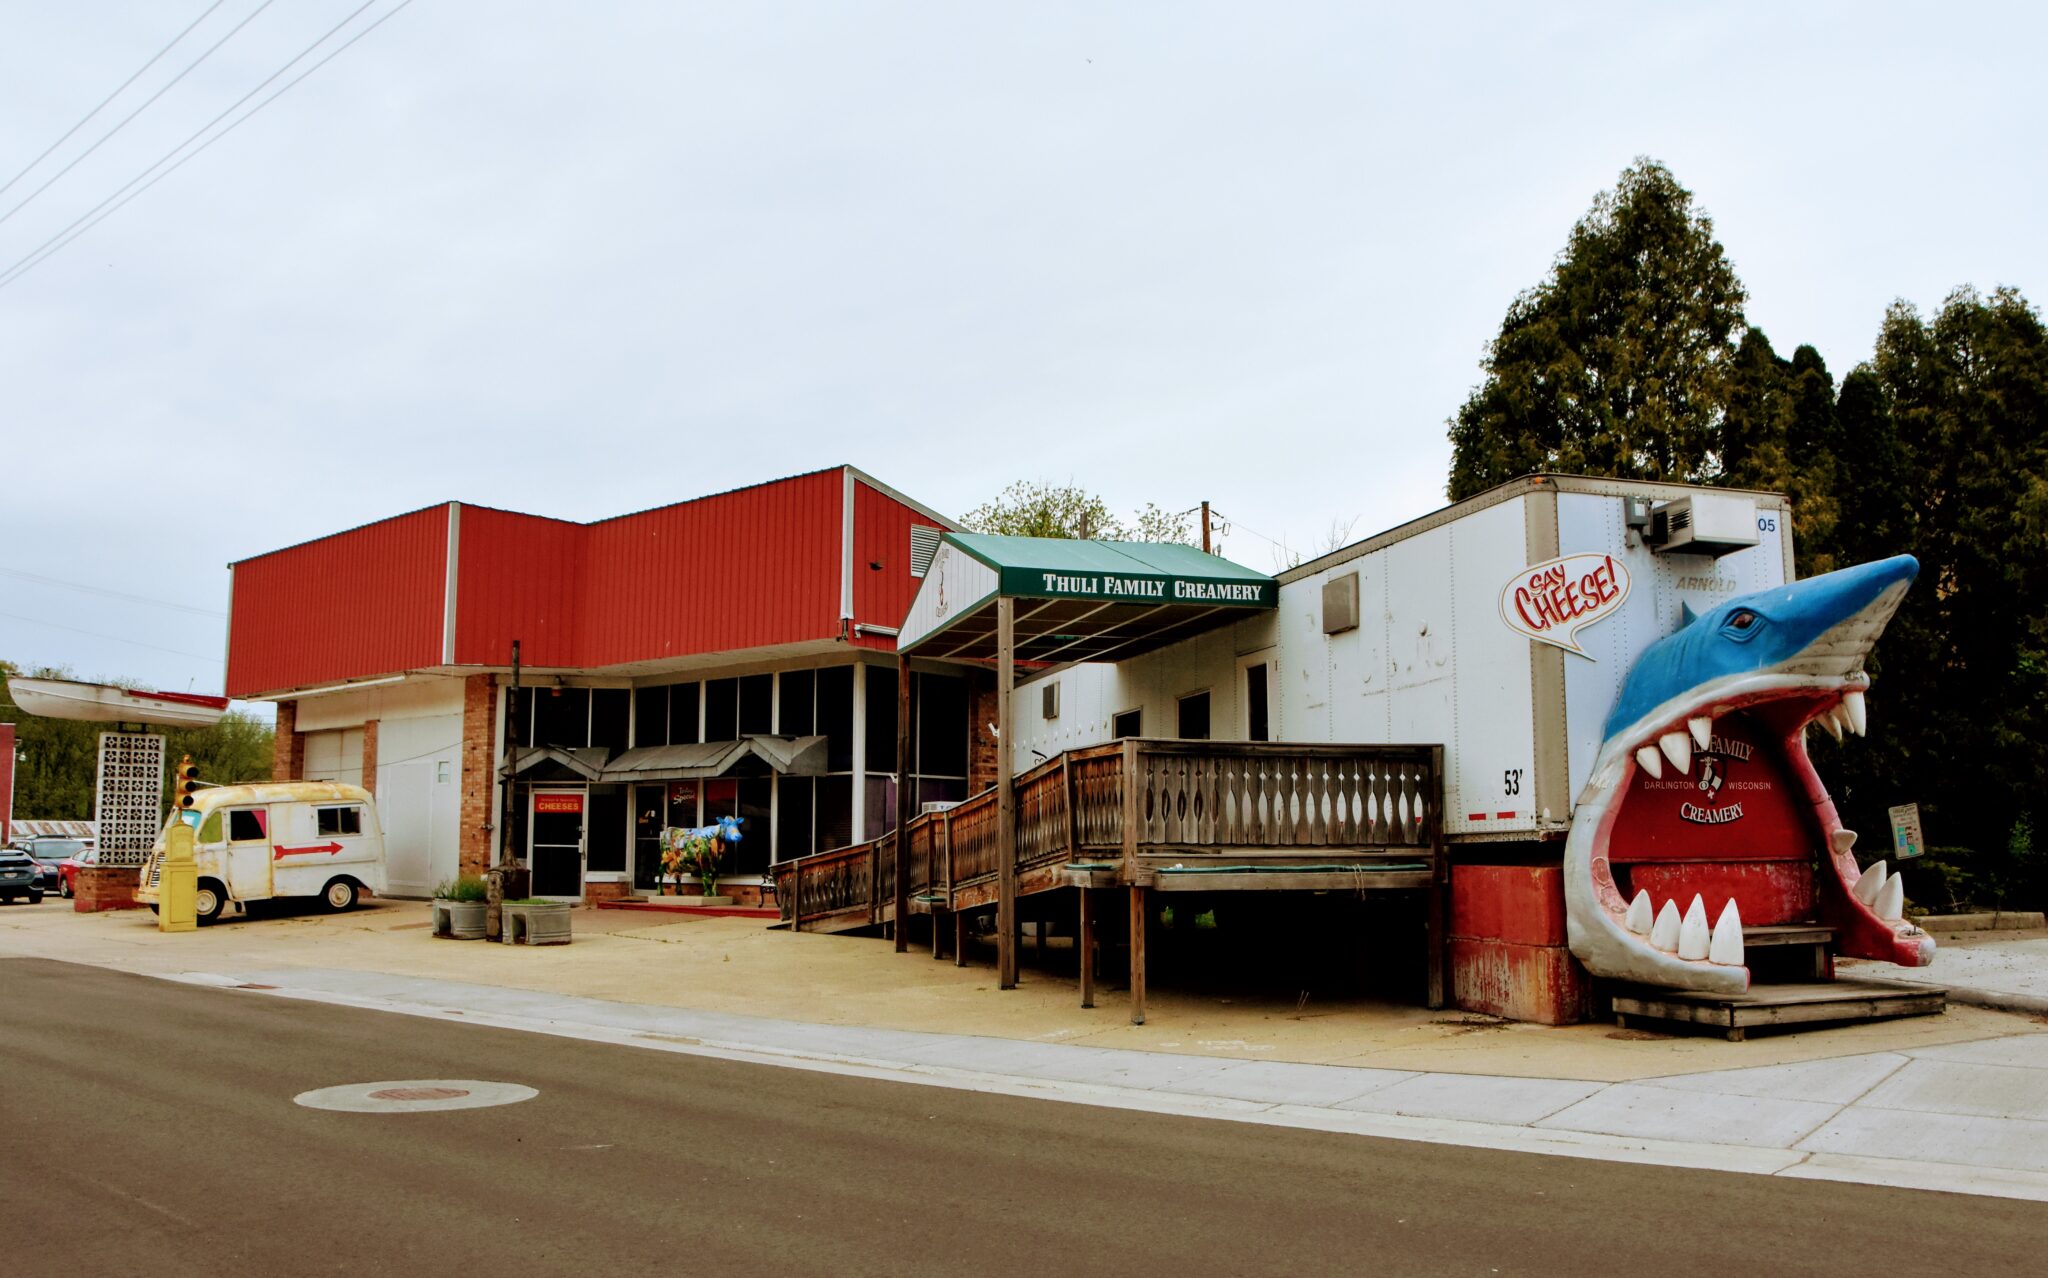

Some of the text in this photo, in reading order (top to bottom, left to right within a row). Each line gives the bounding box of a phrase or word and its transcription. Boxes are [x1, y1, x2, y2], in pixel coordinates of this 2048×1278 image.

[1757, 518, 1776, 532] 05
[1043, 573, 1262, 601] THULI FAMILY CREAMERY
[1529, 564, 1565, 594] SAY
[1675, 576, 1736, 592] ARNOLD
[1514, 555, 1619, 631] CHEESE!
[1709, 735, 1754, 760] FAMILY
[1504, 768, 1523, 796] 53'
[1644, 781, 1771, 790] DARLINGTON WISCONSIN
[538, 802, 579, 810] CHEESES
[1681, 802, 1743, 823] CREAMERY
